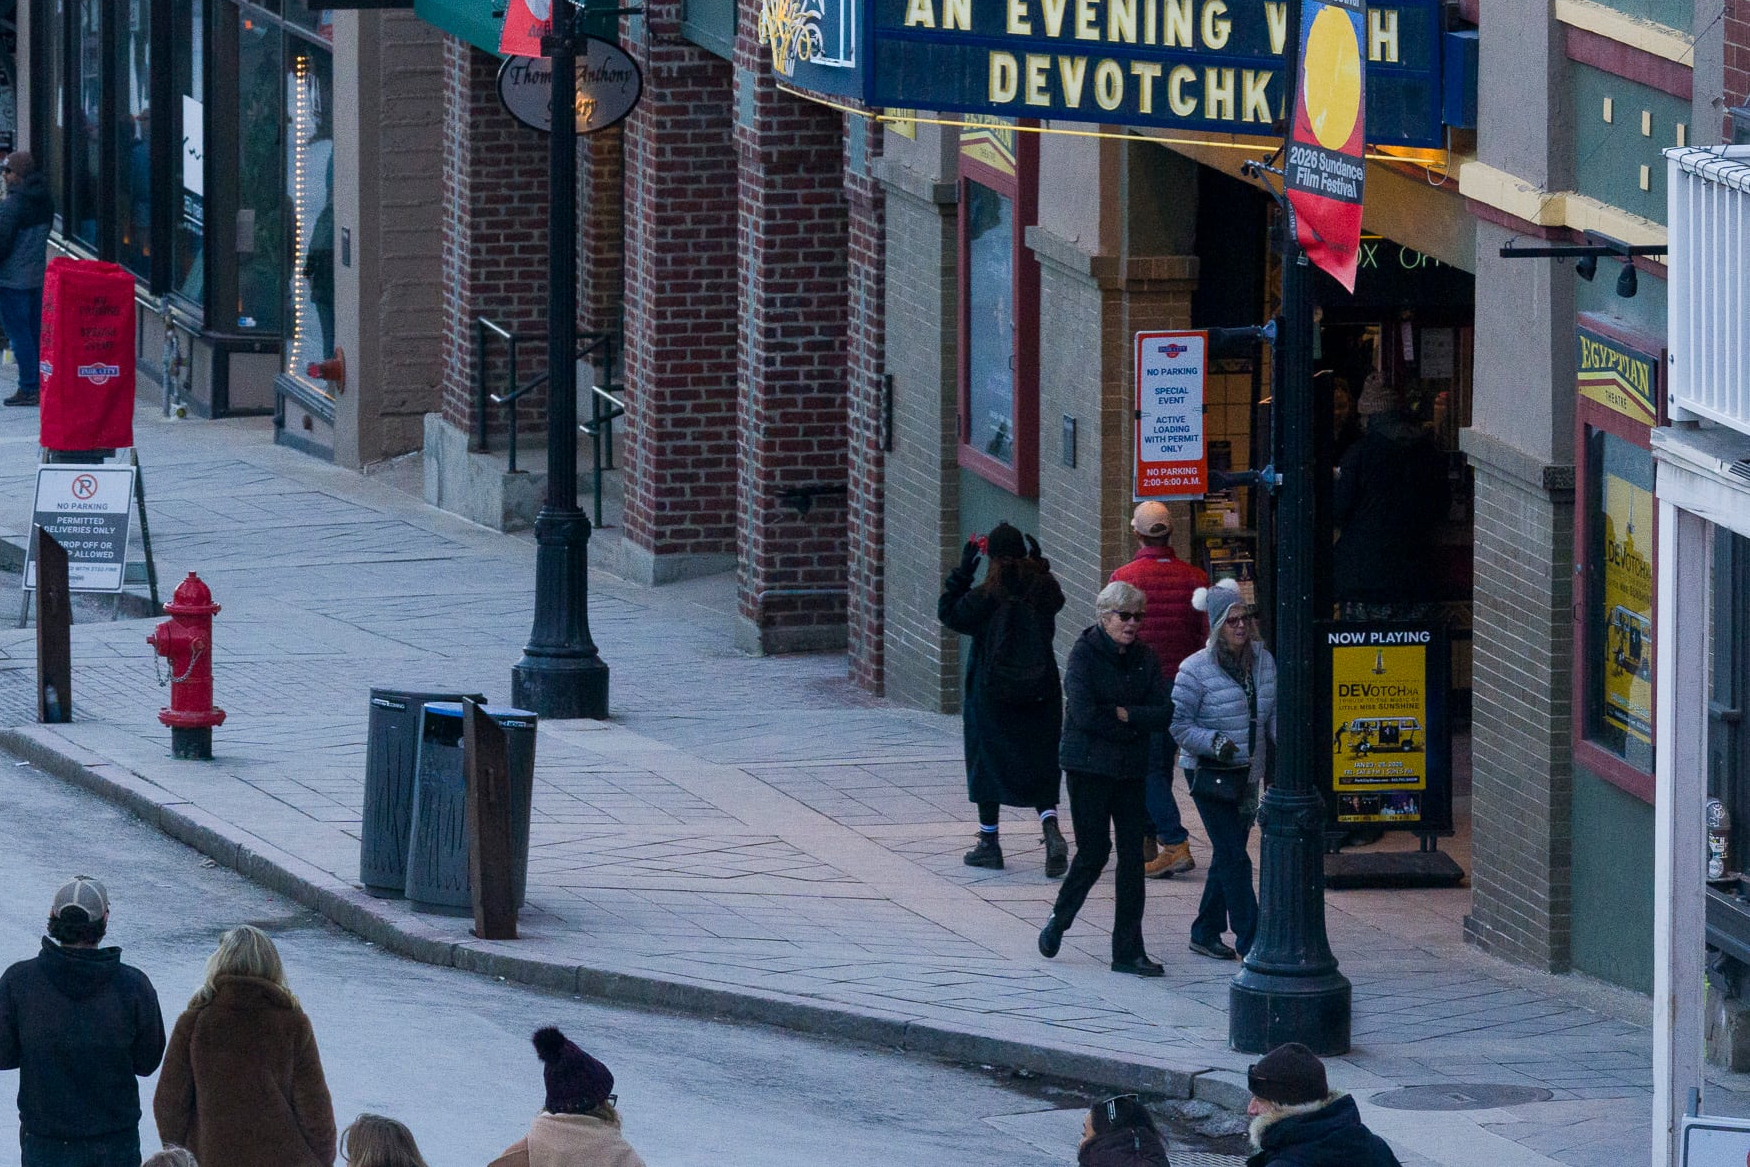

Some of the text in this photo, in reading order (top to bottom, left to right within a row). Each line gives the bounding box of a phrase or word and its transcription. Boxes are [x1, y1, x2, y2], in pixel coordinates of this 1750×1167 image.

[510, 58, 552, 86] Thom
[988, 50, 1287, 123] DEVOTCHK
[1289, 146, 1364, 181] 2026 Sundance
[1296, 167, 1357, 198] Film Festival
[1579, 335, 1649, 397] EGYPTIAN
[1146, 368, 1159, 376] NO
[1155, 387, 1189, 395] SPECIAL
[1158, 397, 1185, 405] EVENT
[1156, 416, 1186, 424] ACTIVE
[1153, 426, 1190, 434] LOADING
[1145, 434, 1199, 443] WITH PERMIT
[1160, 445, 1183, 453] ONLY
[1146, 467, 1197, 476] NO PARKING
[1143, 477, 1201, 487] 2:00-6:00 A.M.
[57, 517, 105, 525] PERMITTED
[44, 525, 116, 534] DELIVERIES ONLY
[82, 541, 99, 549] OFF
[74, 550, 114, 559] ALLOWED
[1328, 631, 1431, 644] NOW PLAYING
[1378, 702, 1420, 710] SUNSHINE
